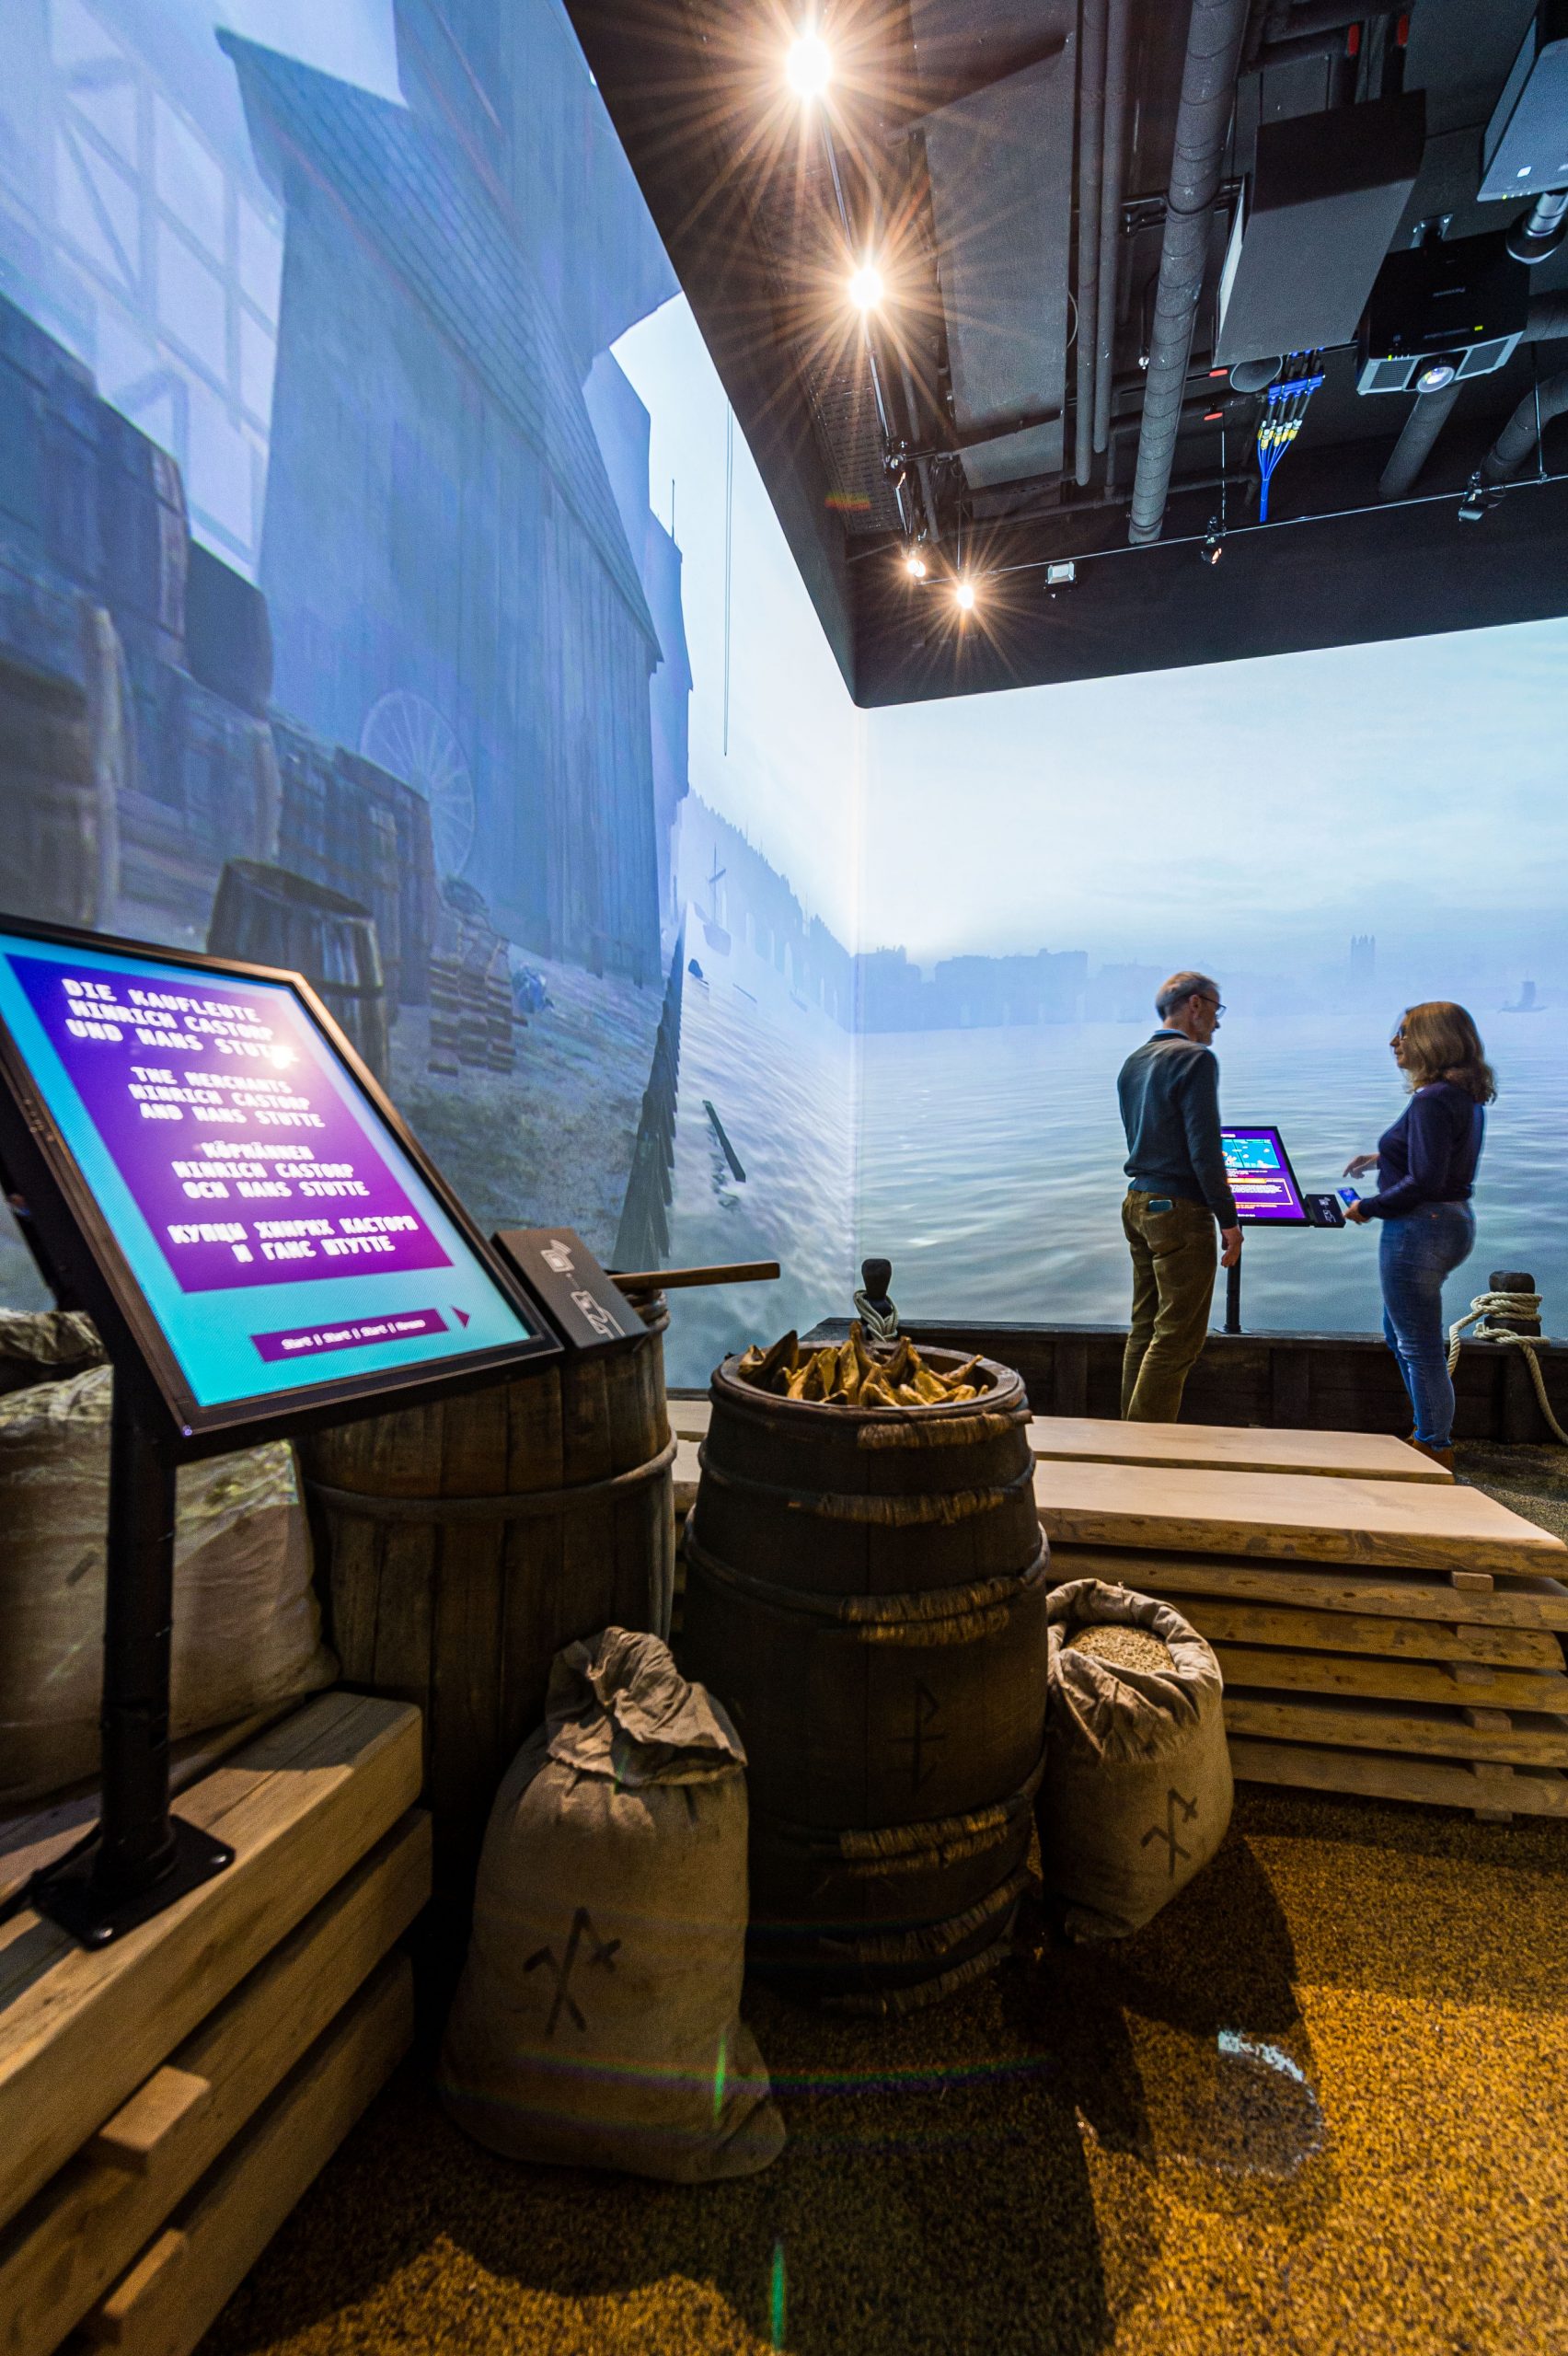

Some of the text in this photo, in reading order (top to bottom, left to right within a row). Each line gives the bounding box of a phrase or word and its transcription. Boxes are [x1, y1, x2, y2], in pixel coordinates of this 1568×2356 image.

[61, 978, 262, 1022] DIE KAUFLEUTE
[67, 999, 274, 1041] HINRICH CASTORP
[64, 1019, 300, 1063] UND HANS STUT
[130, 1066, 293, 1094] THE MERCHANTS
[128, 1083, 310, 1112] HINRICH CASTORP
[139, 1103, 326, 1128] AND HANS STUTTE
[171, 1161, 354, 1179] HINRICH CASTORP
[182, 1180, 370, 1199] OCH HANS STUTTE
